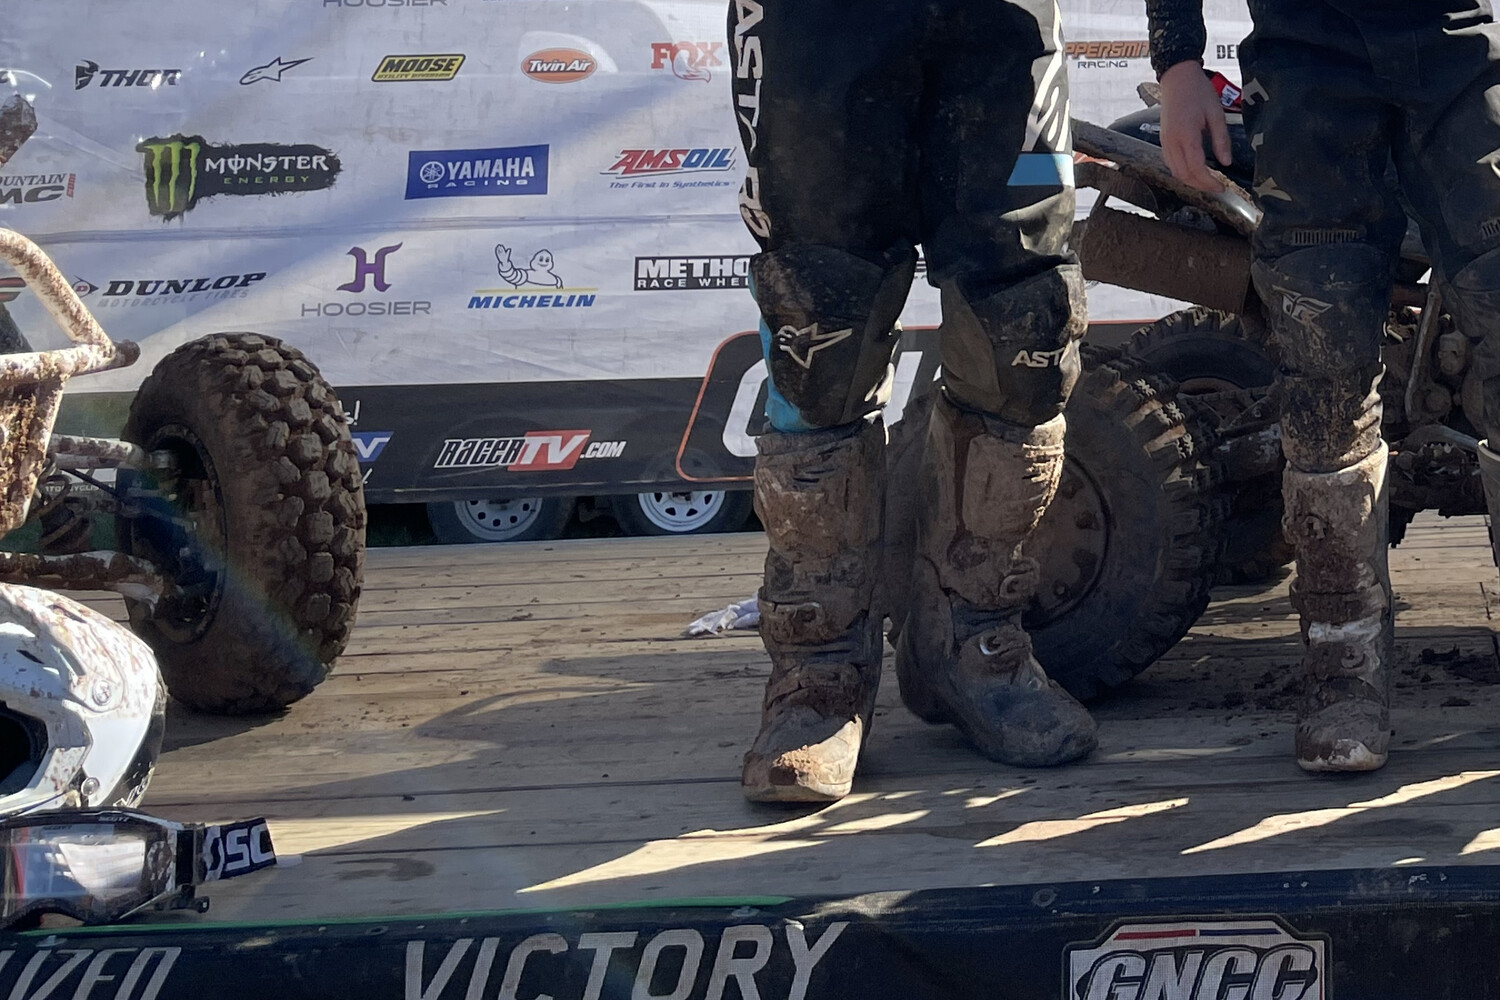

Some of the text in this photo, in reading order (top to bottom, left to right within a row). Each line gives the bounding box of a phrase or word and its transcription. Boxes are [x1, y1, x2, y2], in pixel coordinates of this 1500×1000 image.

[384, 57, 462, 73] MOOSE
[528, 59, 592, 74] Twin Air
[650, 42, 723, 76] FOX
[205, 152, 330, 175] MONSTER
[445, 156, 535, 182] YAMAHA
[611, 147, 737, 175] AMSOIL
[223, 175, 310, 185] ENERGY
[427, 179, 529, 190] RACING
[609, 179, 731, 189] The First Synthetics
[102, 272, 267, 297] DUNLOP
[637, 279, 687, 288] RACE
[300, 301, 432, 317] HOOSIER
[467, 294, 596, 309] MICHELIN
[404, 921, 852, 1000] VICTORY
[1083, 944, 1317, 1000] GNCC
